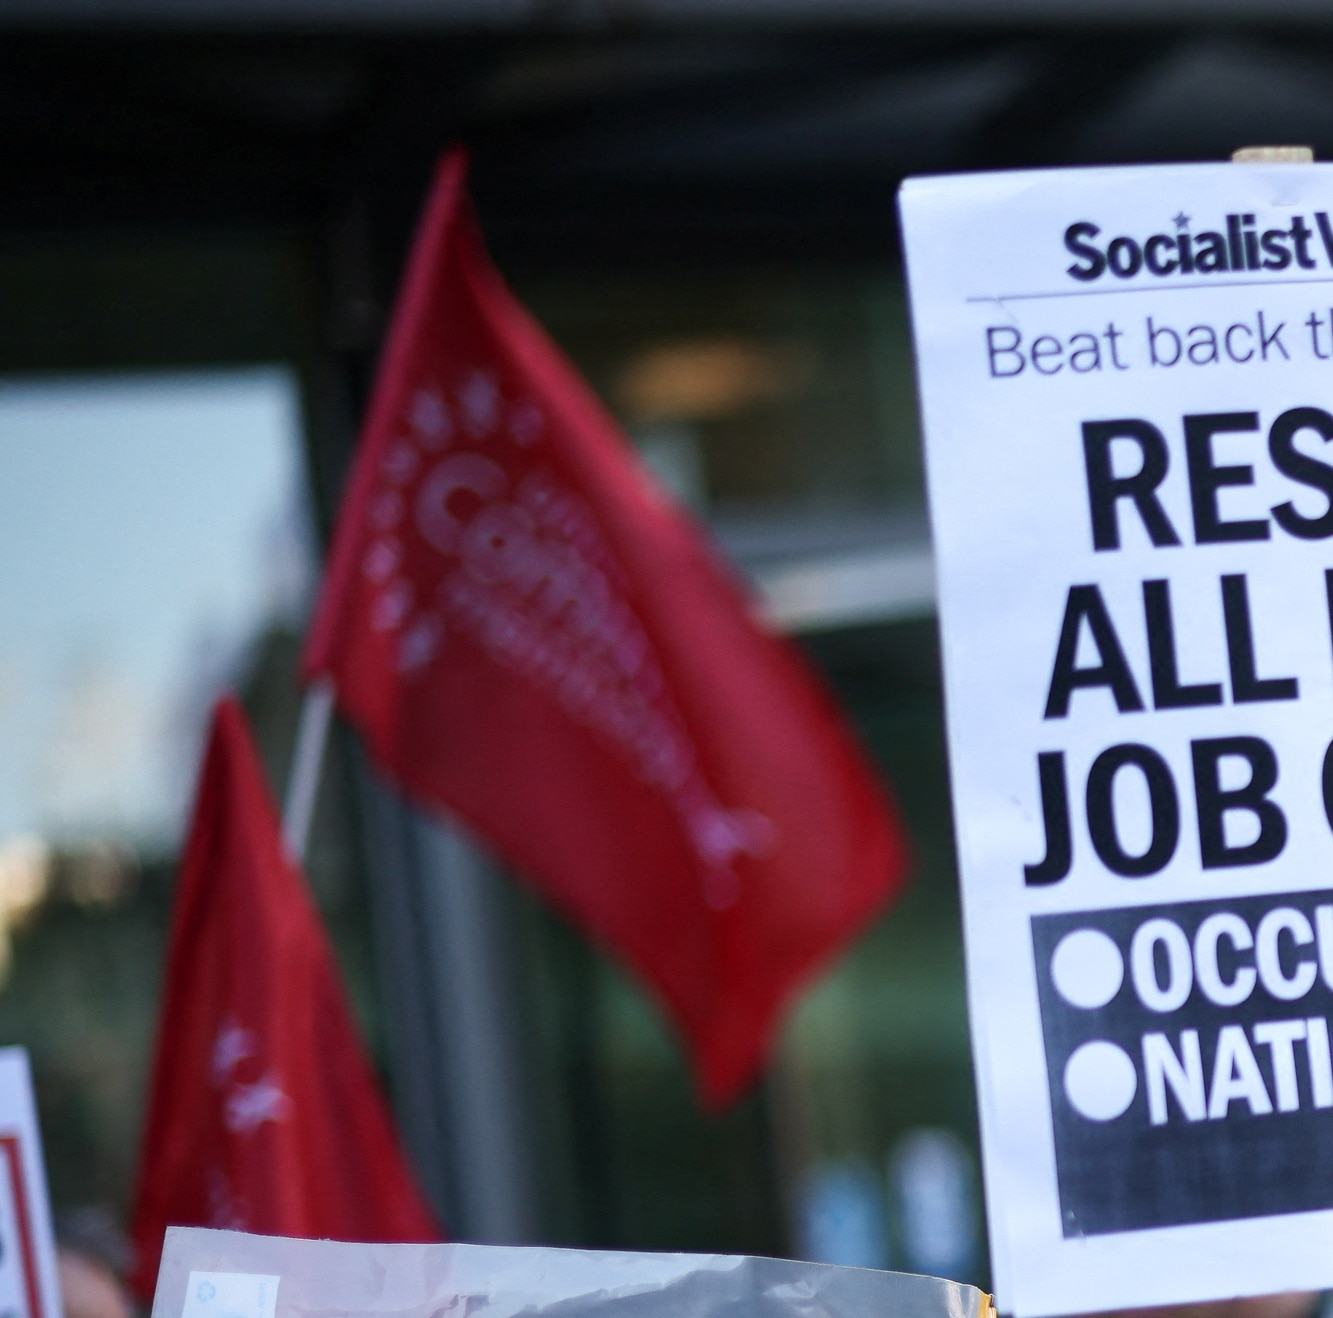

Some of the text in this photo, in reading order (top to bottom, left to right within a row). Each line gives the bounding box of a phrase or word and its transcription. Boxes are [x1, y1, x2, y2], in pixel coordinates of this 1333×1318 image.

[1064, 211, 1316, 282] Socialist
[985, 319, 1130, 379] Beat
[1146, 310, 1292, 367] back
[1043, 573, 1300, 720] ALL
[1023, 735, 1289, 888] JOB
